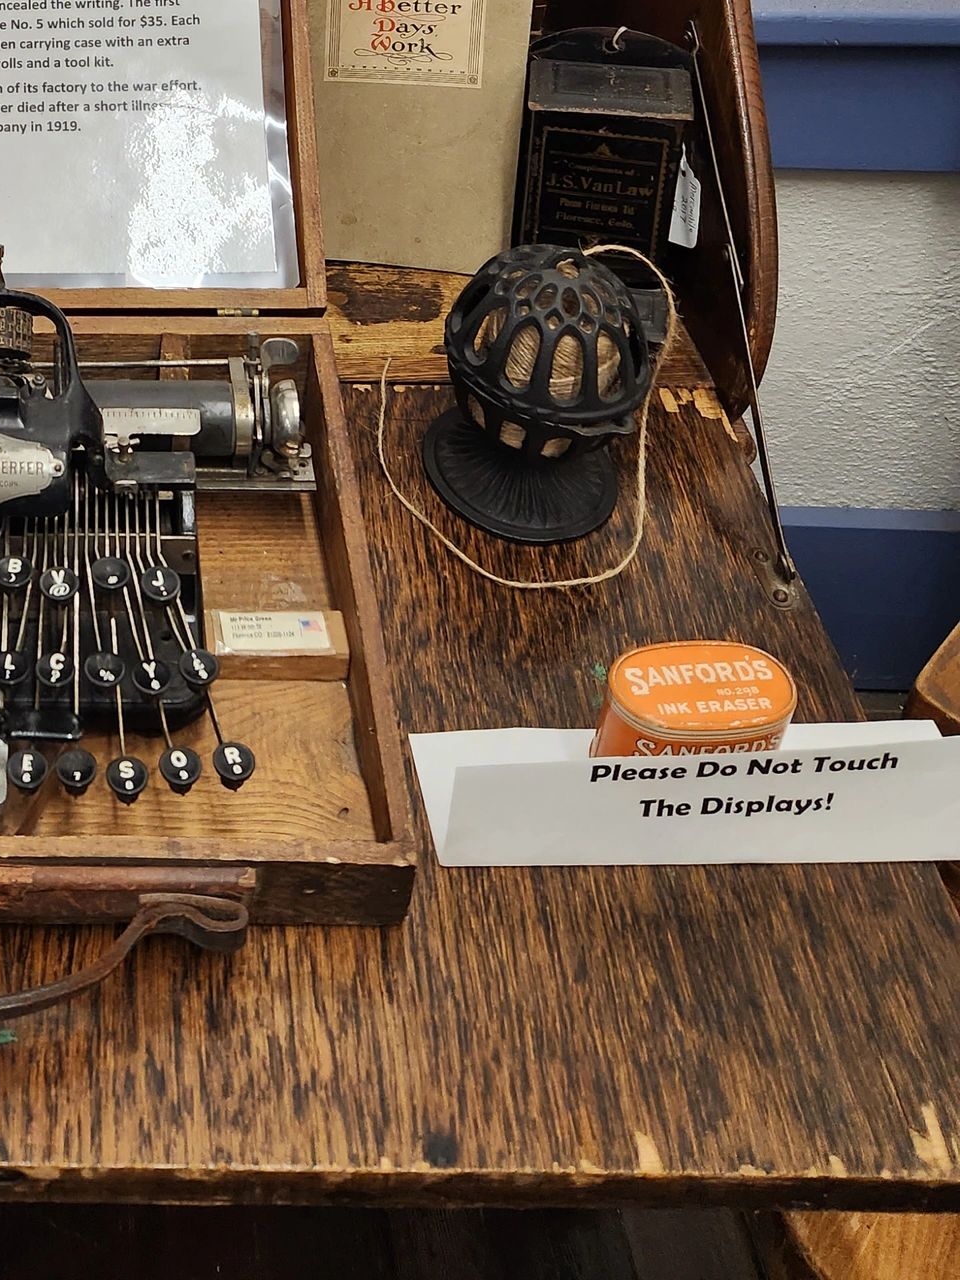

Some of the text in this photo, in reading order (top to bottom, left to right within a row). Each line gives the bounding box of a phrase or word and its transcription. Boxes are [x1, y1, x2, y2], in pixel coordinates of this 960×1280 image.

[373, 17, 437, 39] Days
[370, 33, 440, 60] Work
[30, 120, 43, 133] in
[46, 120, 82, 133] 1919.
[624, 655, 773, 696] SANFORD'S
[657, 697, 772, 716] INK ERASER
[22, 753, 34, 771] E
[170, 750, 188, 768] O
[223, 746, 243, 765] R
[118, 760, 135, 779] S
[590, 752, 898, 782] Please Do Not Touch
[639, 793, 834, 817] The Displays!
